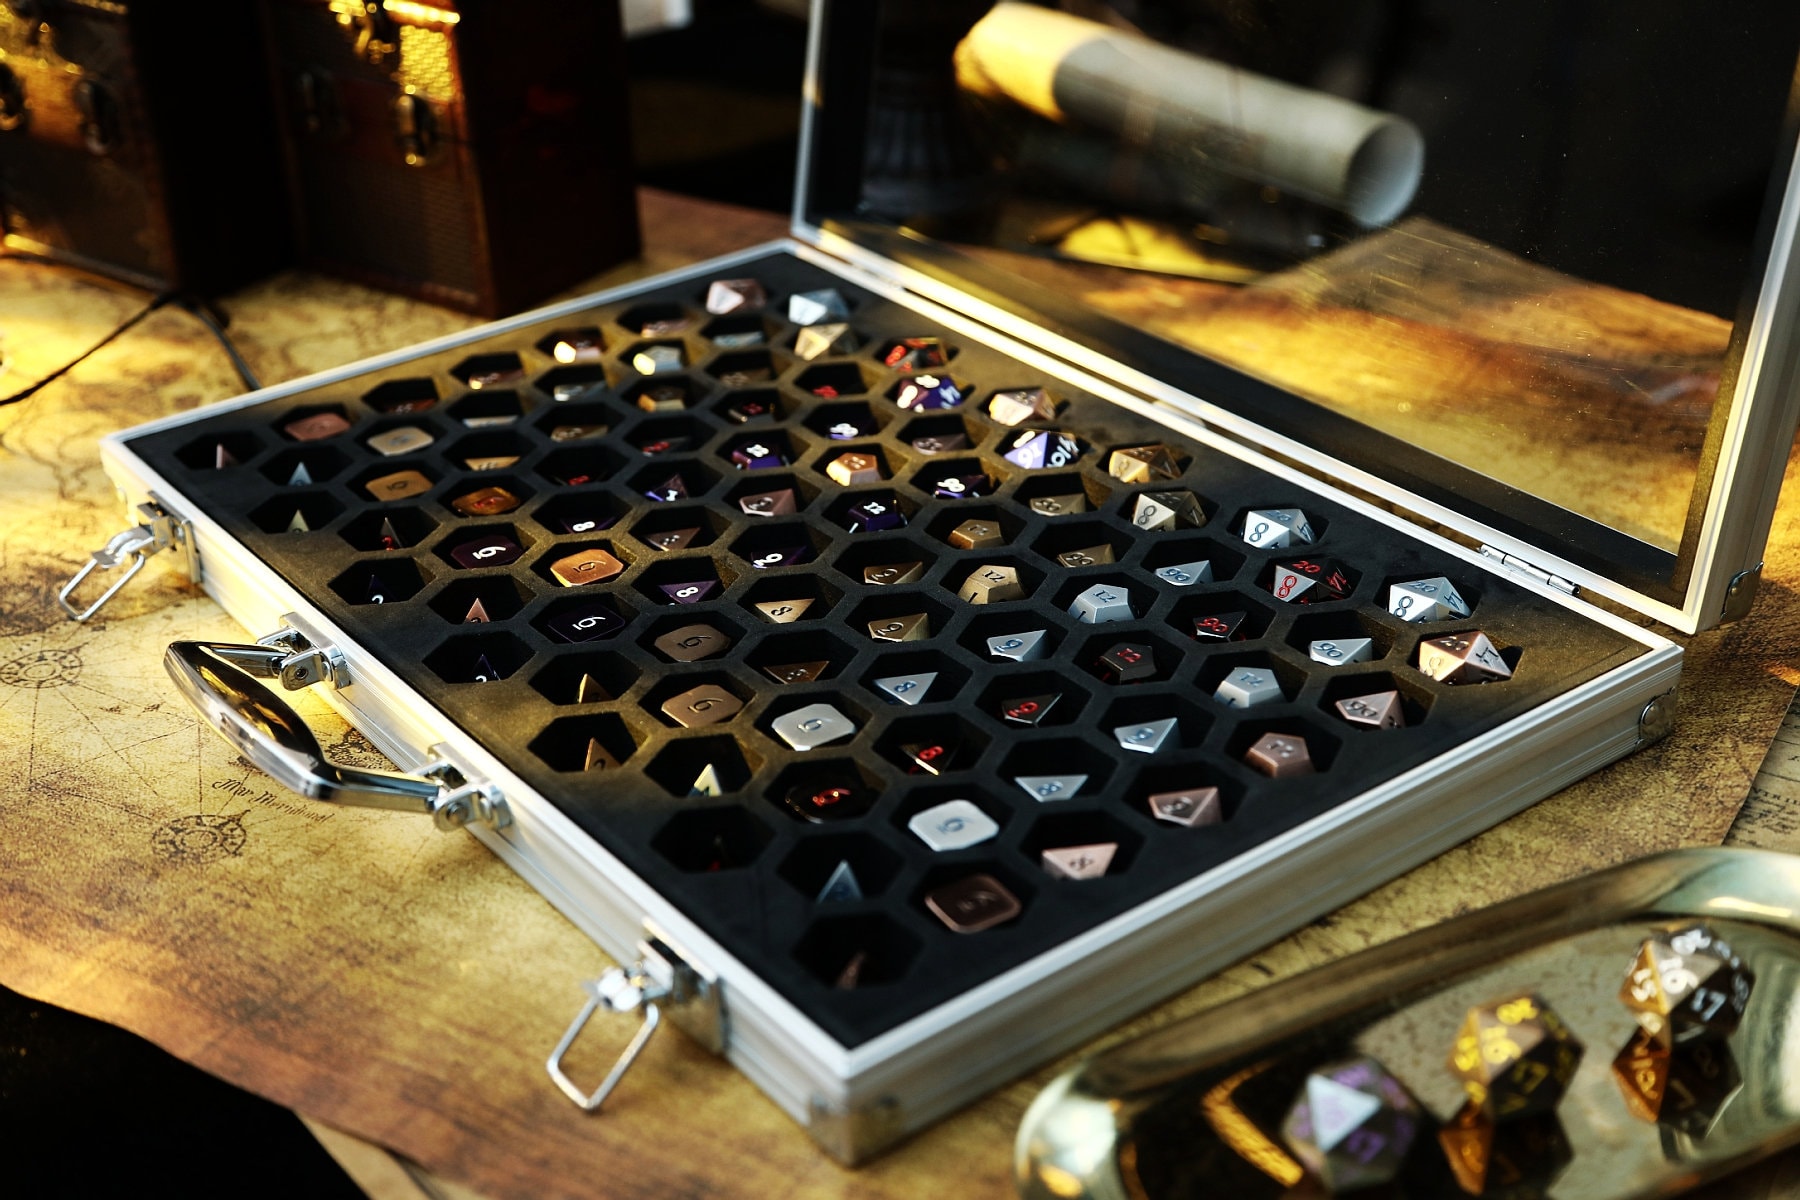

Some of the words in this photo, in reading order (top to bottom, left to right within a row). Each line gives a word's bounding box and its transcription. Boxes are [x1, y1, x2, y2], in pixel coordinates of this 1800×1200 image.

[1138, 505, 1157, 525] 8
[572, 520, 596, 532] 8
[1249, 522, 1269, 542] 8
[1065, 552, 1095, 566] 90
[1291, 559, 1322, 574] 20
[982, 570, 1006, 583] 12
[1160, 568, 1192, 582] 90
[675, 586, 699, 598] 8
[1276, 575, 1297, 598] 8
[1408, 582, 1438, 593] 20
[1093, 590, 1117, 603] 12
[770, 606, 793, 616] 8
[1394, 595, 1414, 617] 8
[1196, 616, 1229, 633] 90
[1116, 647, 1142, 663] 12
[1312, 642, 1343, 658] 90
[894, 680, 918, 692] 8
[918, 745, 945, 761] 8
[212, 778, 255, 797] Mar
[1038, 781, 1064, 797] 8
